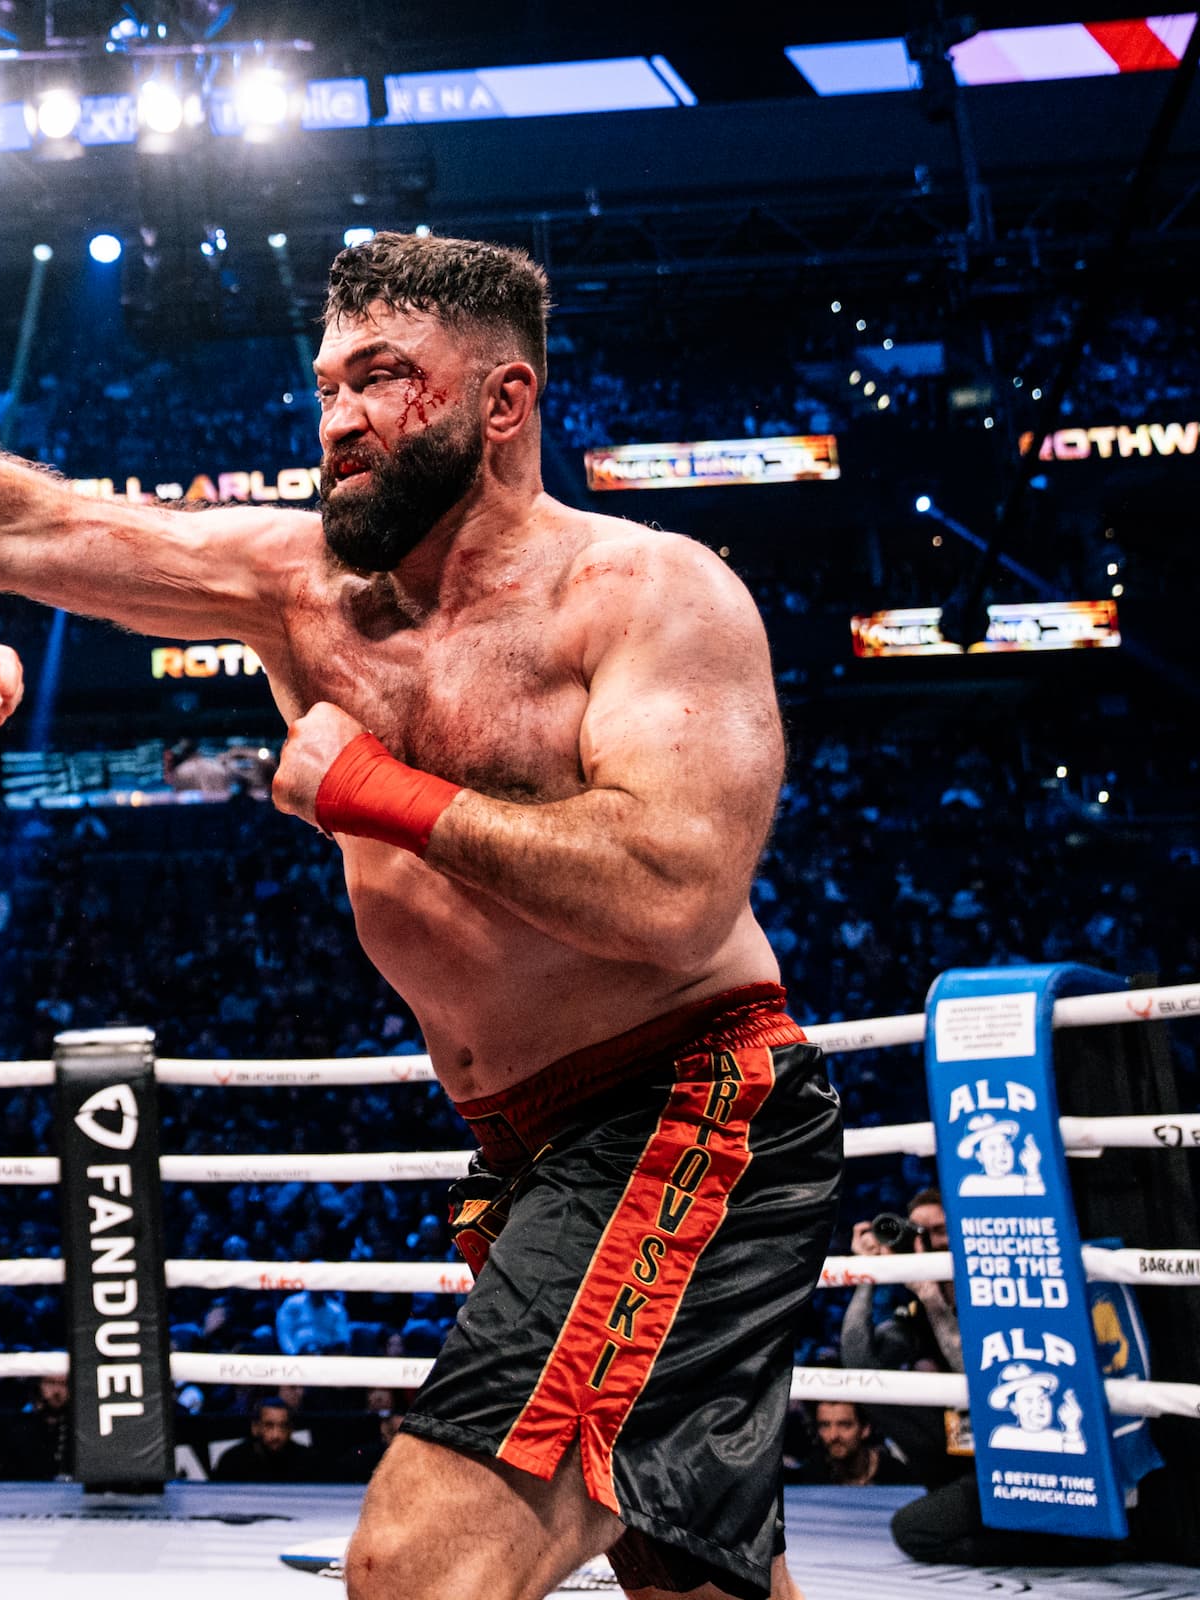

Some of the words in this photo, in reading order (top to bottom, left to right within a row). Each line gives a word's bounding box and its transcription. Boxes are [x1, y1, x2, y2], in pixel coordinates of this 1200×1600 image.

[390, 84, 494, 116] RENA
[948, 1079, 1037, 1124] ALP
[961, 1217, 1057, 1236] NICOTINE
[964, 1237, 1060, 1256] POUCHES
[966, 1256, 1011, 1276] FOR
[1015, 1256, 1064, 1277] THE
[86, 1164, 144, 1437] FANDUEL
[969, 1276, 1069, 1309] BOLD
[980, 1328, 1077, 1371] ALP
[991, 1469, 1003, 1484] A
[1004, 1470, 1058, 1489] BETTER
[993, 1484, 1098, 1507] ALPPOUCH.COM
